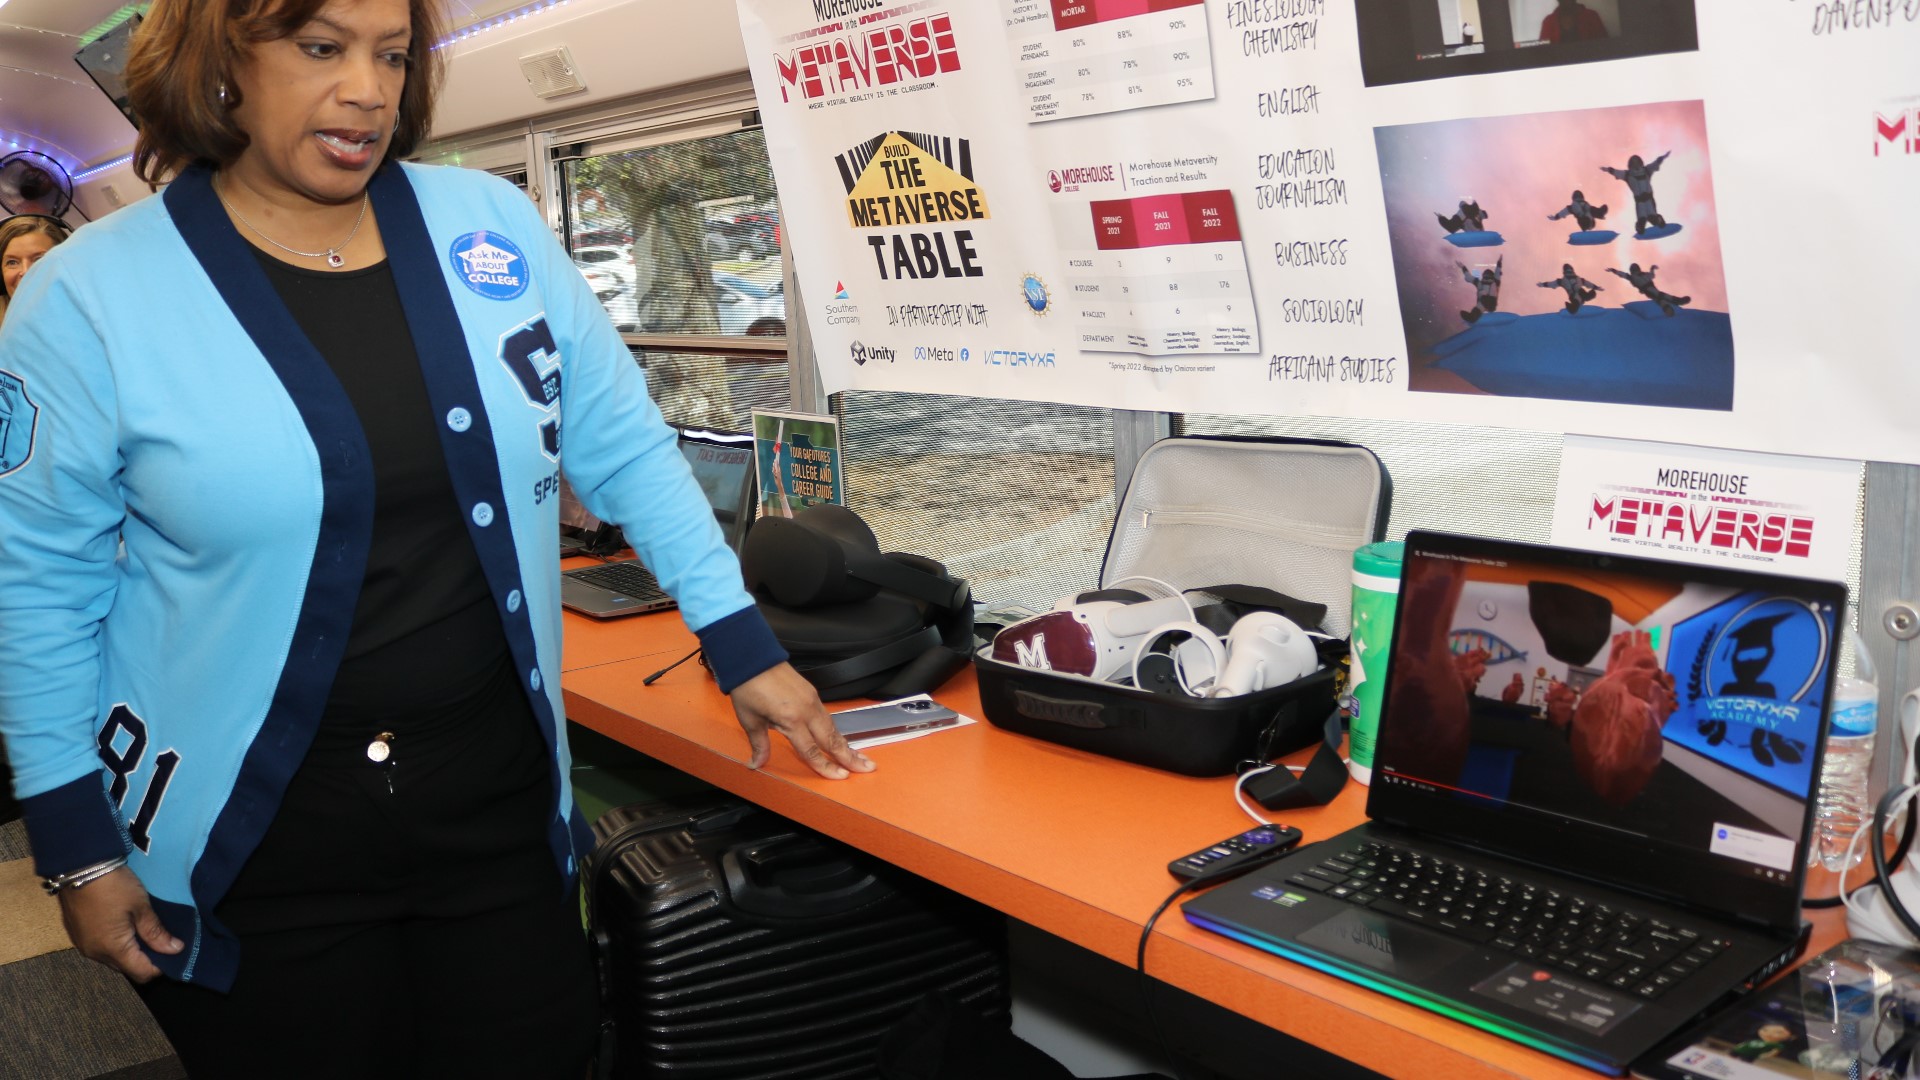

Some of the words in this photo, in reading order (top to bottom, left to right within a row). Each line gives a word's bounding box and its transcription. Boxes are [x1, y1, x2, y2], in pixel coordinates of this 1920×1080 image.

[1061, 5, 1087, 18] MORTAR
[1169, 20, 1187, 30] 90%
[1243, 19, 1318, 57] CHEMISTRY
[773, 12, 962, 103] METAVERSE
[1172, 52, 1190, 62] 90%
[1176, 78, 1193, 88] 95%
[808, 101, 824, 110] WHERE
[850, 93, 875, 103] REALITY
[877, 91, 884, 99] IS
[887, 88, 898, 97] THE
[1258, 85, 1321, 118] ENGLISH
[1873, 108, 1920, 157] M
[883, 143, 910, 159] BUILD
[1129, 160, 1172, 172] Morehouse
[1173, 155, 1218, 167] Metaversity
[1258, 148, 1335, 180] EDUCATION
[880, 157, 926, 190] THE
[1061, 164, 1115, 185] MOREHOUSE
[1131, 174, 1164, 187] Traction
[1165, 174, 1179, 184] and
[1180, 172, 1208, 182] Results
[1255, 178, 1348, 210] JOURNALISM
[849, 188, 985, 227] METAVERSE
[1153, 211, 1169, 220] FALL
[1202, 208, 1219, 217] FALL
[1102, 216, 1123, 224] SPRING
[1154, 222, 1171, 231] 2021
[1203, 219, 1222, 228] 2022
[467, 250, 489, 260] Ask
[492, 251, 509, 260] Me
[867, 230, 984, 280] TABLE
[1214, 253, 1224, 261] 10
[1274, 239, 1349, 268] BUSINESS
[475, 262, 505, 271] ABOUT
[468, 273, 519, 286] COLLEGE
[825, 302, 859, 315] Southern
[886, 305, 900, 326] IN
[900, 303, 963, 328] PARTNERSHIP
[964, 302, 989, 328] WITH
[1282, 298, 1364, 327] SOCIOLOGY
[826, 315, 861, 326] Company
[1082, 334, 1115, 343] DEPARTMENT
[867, 346, 896, 363] Unity
[927, 346, 954, 362] Meta
[984, 350, 1056, 368] VICTORYXR
[1269, 355, 1336, 383] AFRICANA
[1340, 356, 1397, 384] STUDIES
[790, 446, 803, 459] YOUR
[791, 463, 818, 481] COLLEGE
[819, 464, 832, 483] AND
[1657, 468, 1749, 495] MOREHOUSE
[792, 480, 814, 498] CAREER
[815, 484, 834, 500] GUIDE
[1588, 493, 1815, 558] METAVERSE
[1014, 632, 1052, 671] M
[1711, 710, 1780, 730] ACADEMY
